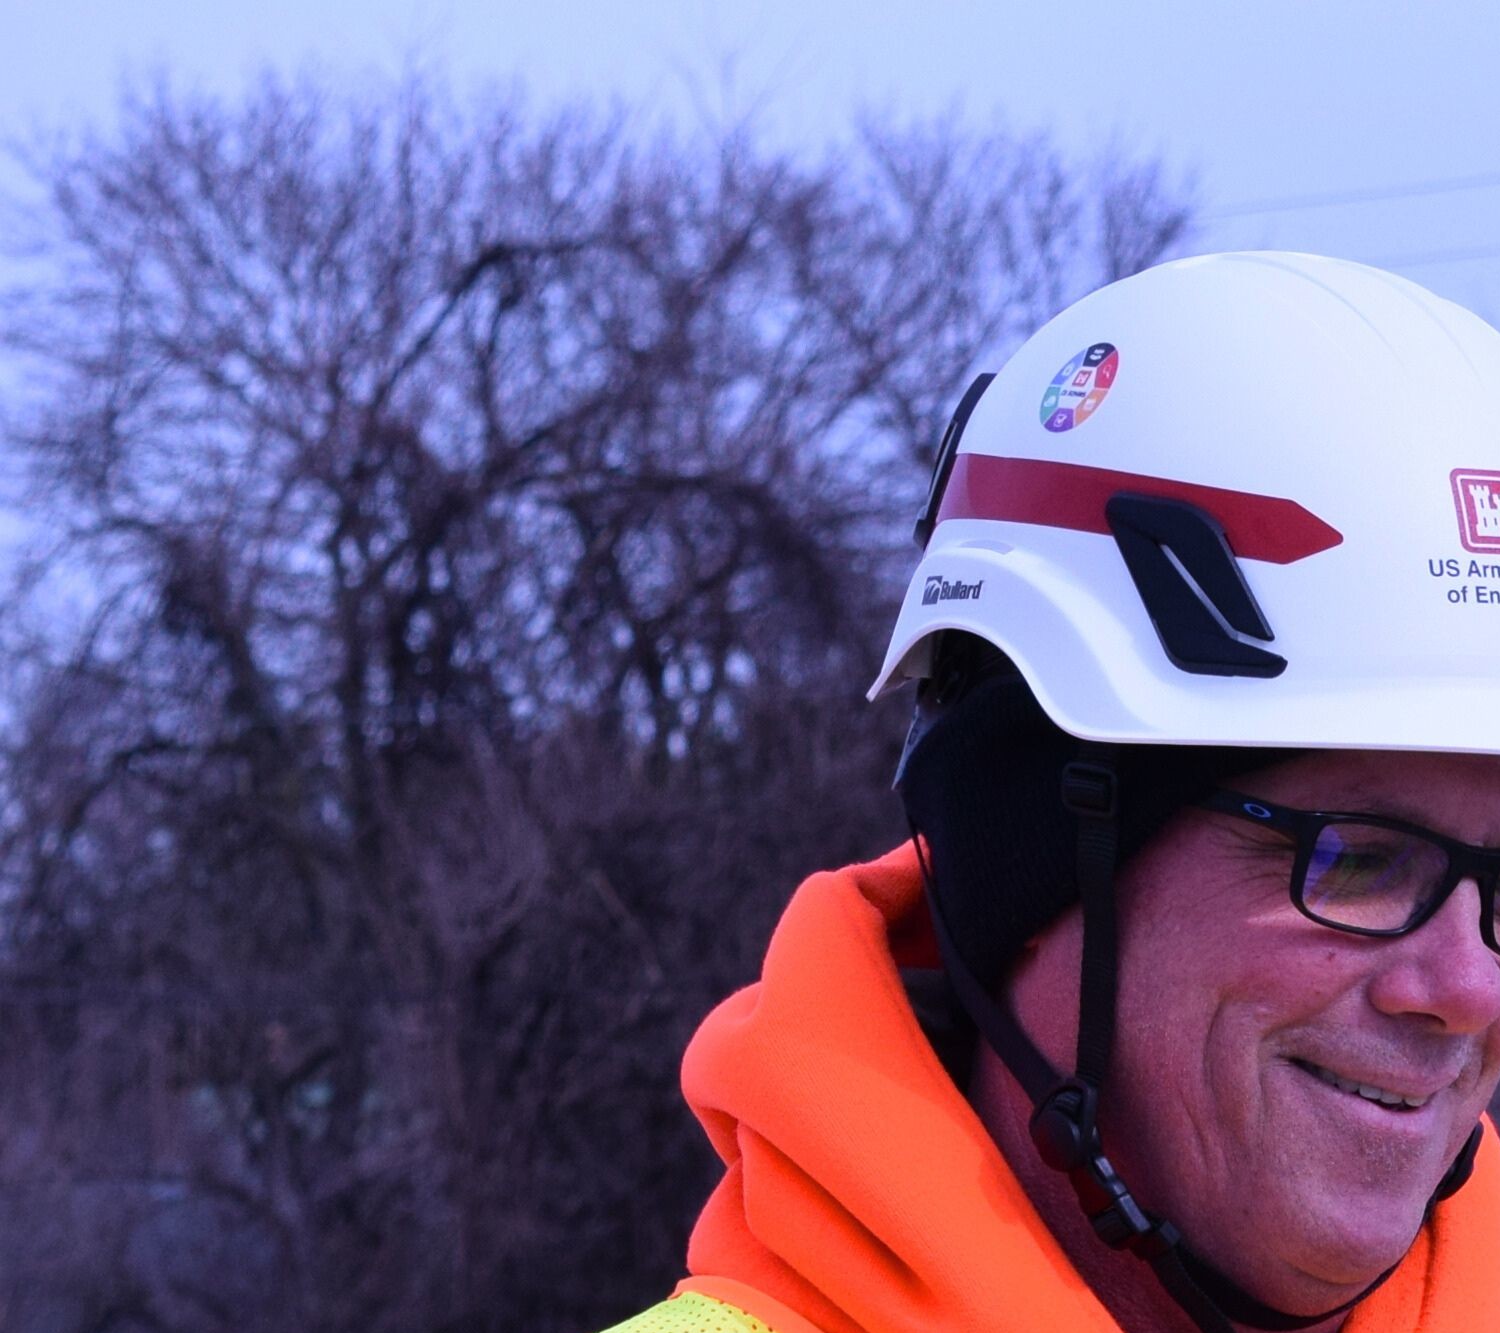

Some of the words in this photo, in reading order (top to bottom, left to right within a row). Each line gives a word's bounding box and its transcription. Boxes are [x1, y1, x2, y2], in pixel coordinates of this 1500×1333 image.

[1428, 558, 1461, 578] US
[940, 580, 984, 600] Bullard
[1447, 585, 1468, 604] of
